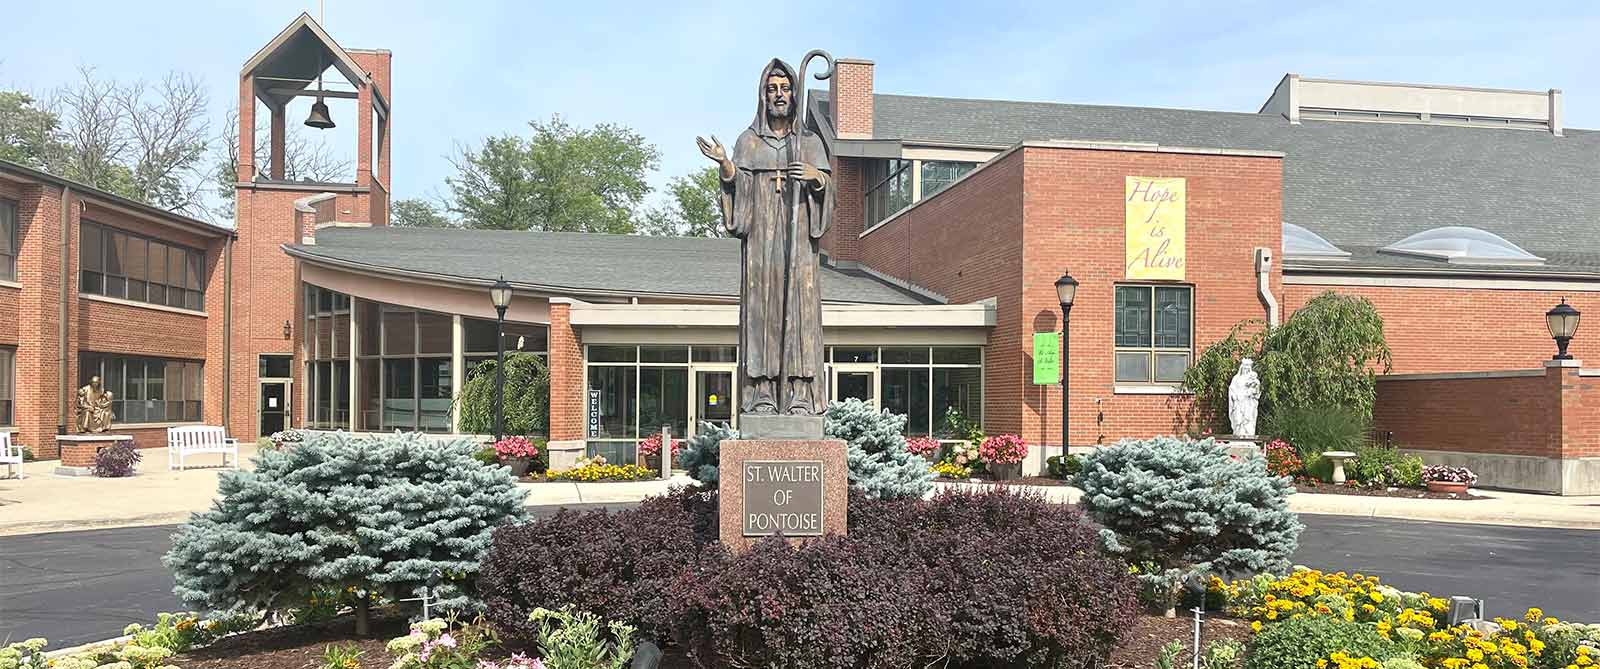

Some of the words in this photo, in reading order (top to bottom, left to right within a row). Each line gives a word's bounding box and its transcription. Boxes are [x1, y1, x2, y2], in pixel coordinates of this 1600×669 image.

[1128, 181, 1179, 223] Hope
[1150, 219, 1165, 237] is
[1128, 238, 1183, 270] Alive
[590, 391, 598, 437] WELCOME
[747, 465, 765, 482] ST.
[768, 465, 820, 482] WALTER
[774, 489, 793, 506] OF
[749, 513, 817, 530] PONTOISE
